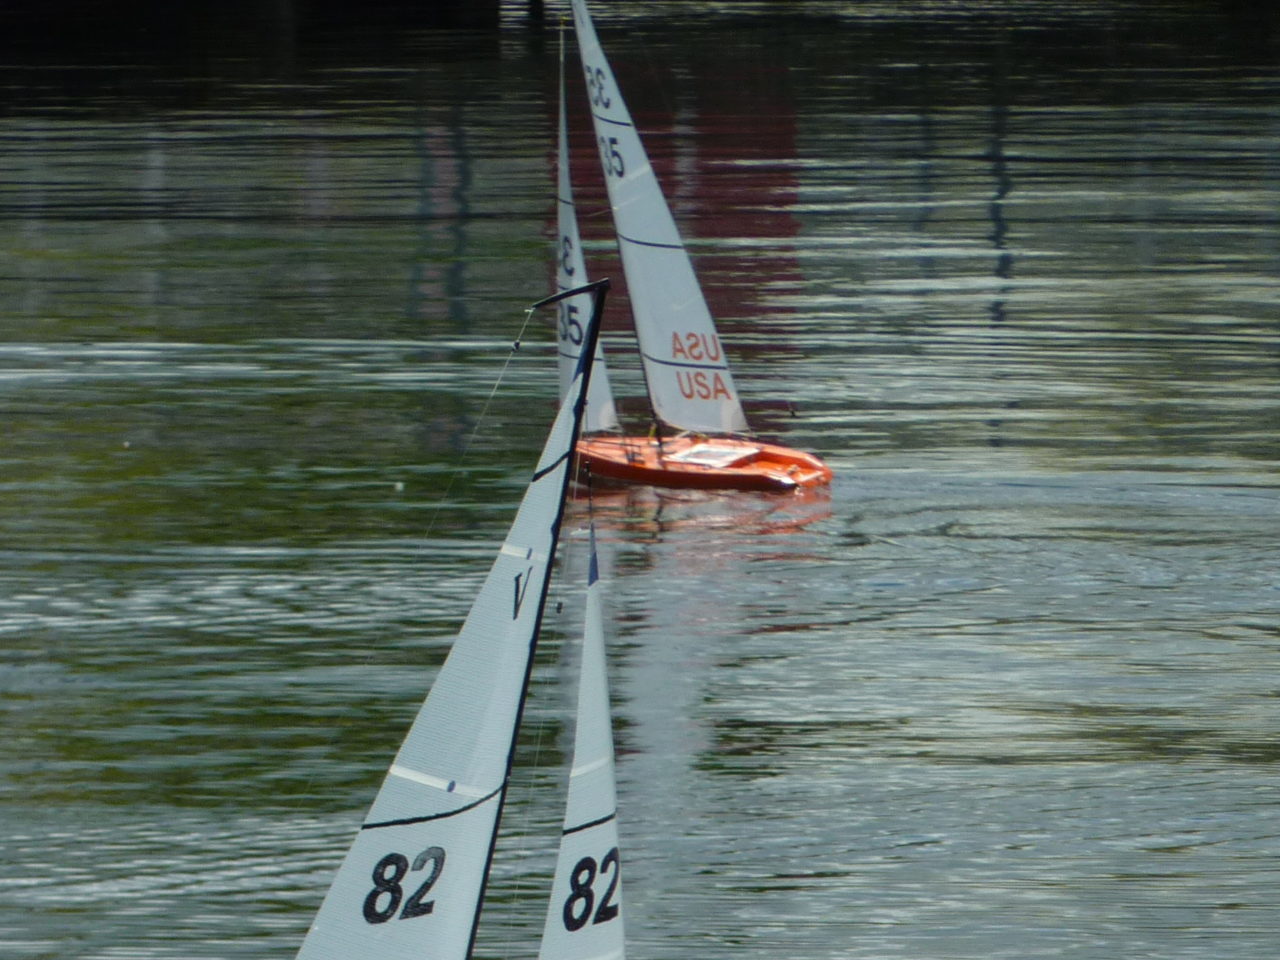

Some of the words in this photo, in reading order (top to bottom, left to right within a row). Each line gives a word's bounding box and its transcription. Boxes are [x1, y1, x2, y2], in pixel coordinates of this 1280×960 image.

[676, 371, 734, 401] USA
[362, 846, 446, 924] 82
[563, 846, 620, 932] 82
